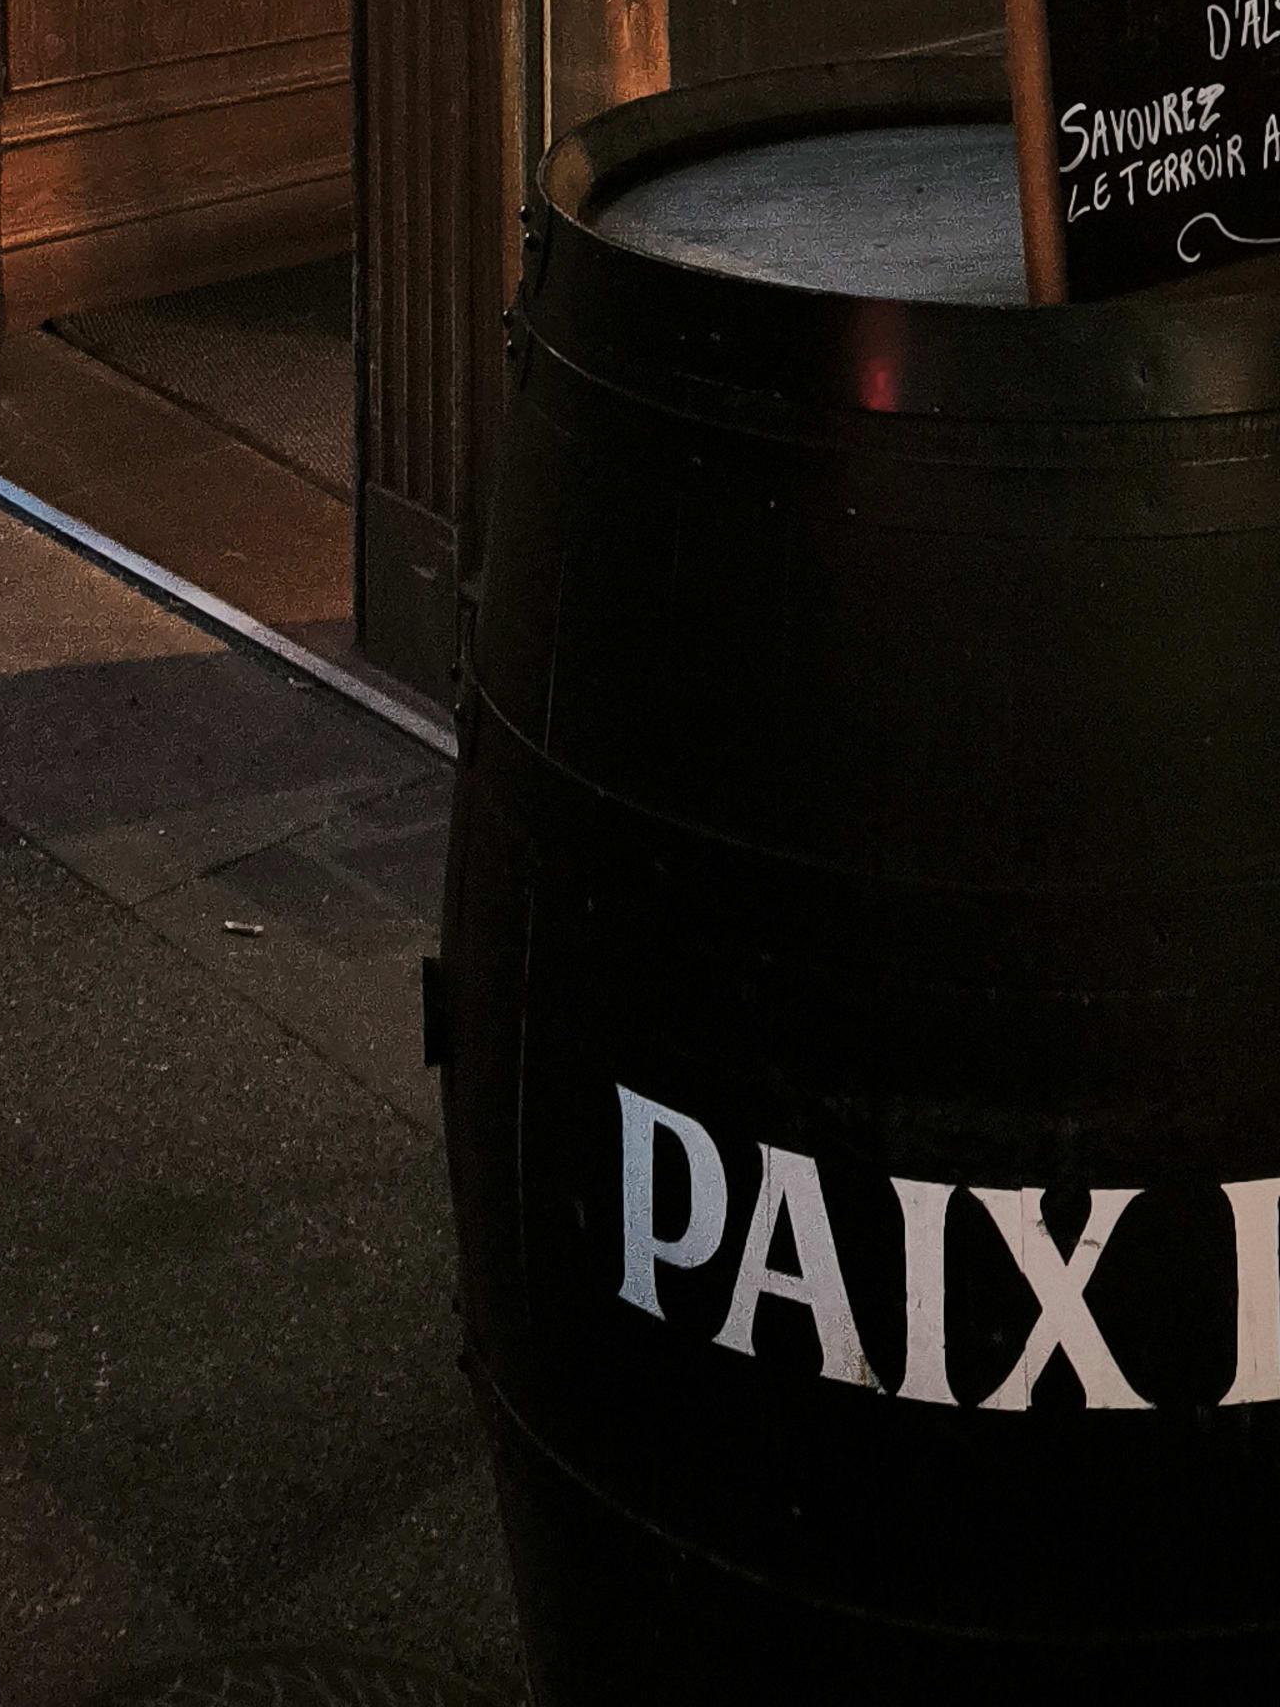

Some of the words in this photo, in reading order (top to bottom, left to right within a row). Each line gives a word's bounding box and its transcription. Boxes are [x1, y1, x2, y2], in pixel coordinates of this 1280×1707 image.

[1059, 84, 1225, 173] SAVOUREZ
[1067, 172, 1111, 223] LE
[615, 1081, 1157, 1412] PAIX
